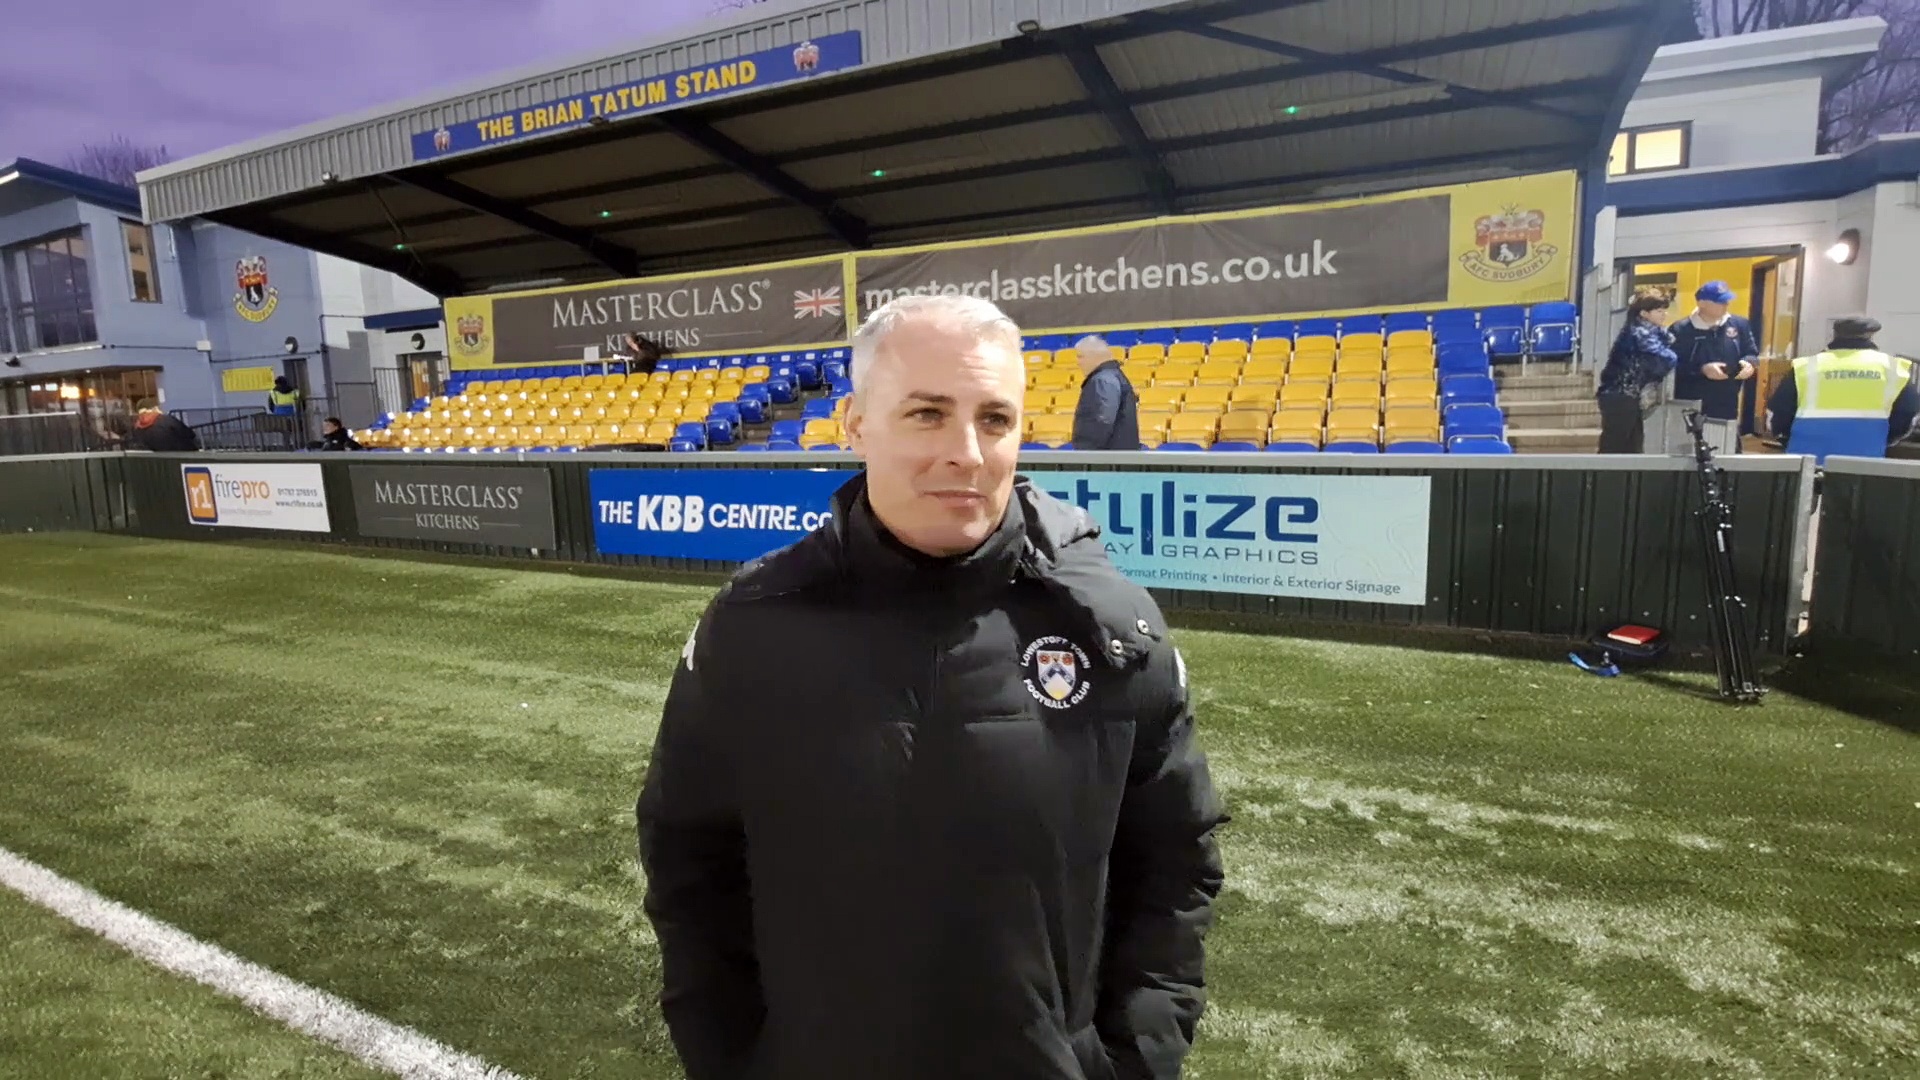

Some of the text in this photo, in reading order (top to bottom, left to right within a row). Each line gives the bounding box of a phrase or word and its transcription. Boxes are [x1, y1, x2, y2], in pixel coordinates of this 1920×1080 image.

[477, 60, 757, 141] THE BRIAN TATUM STAND
[1469, 257, 1544, 279] AFC SUDBURY
[606, 328, 700, 351] KIHENS
[1824, 370, 1882, 380] STEWARD
[215, 474, 271, 504] firepro
[415, 512, 480, 531] KITCHENS
[599, 500, 633, 524] THE
[637, 494, 705, 533] KBB
[1046, 479, 1319, 556] tylize
[1161, 544, 1319, 566] GRAPHICS
[1160, 567, 1208, 584] Printing
[1222, 572, 1270, 585] Interior
[1273, 575, 1285, 587] &
[1287, 575, 1342, 591] Exterior
[1345, 578, 1401, 596] Signage
[1020, 635, 1091, 669] LOWESTOFT TOWN
[1023, 678, 1091, 709] FOOTBALL CLUB
